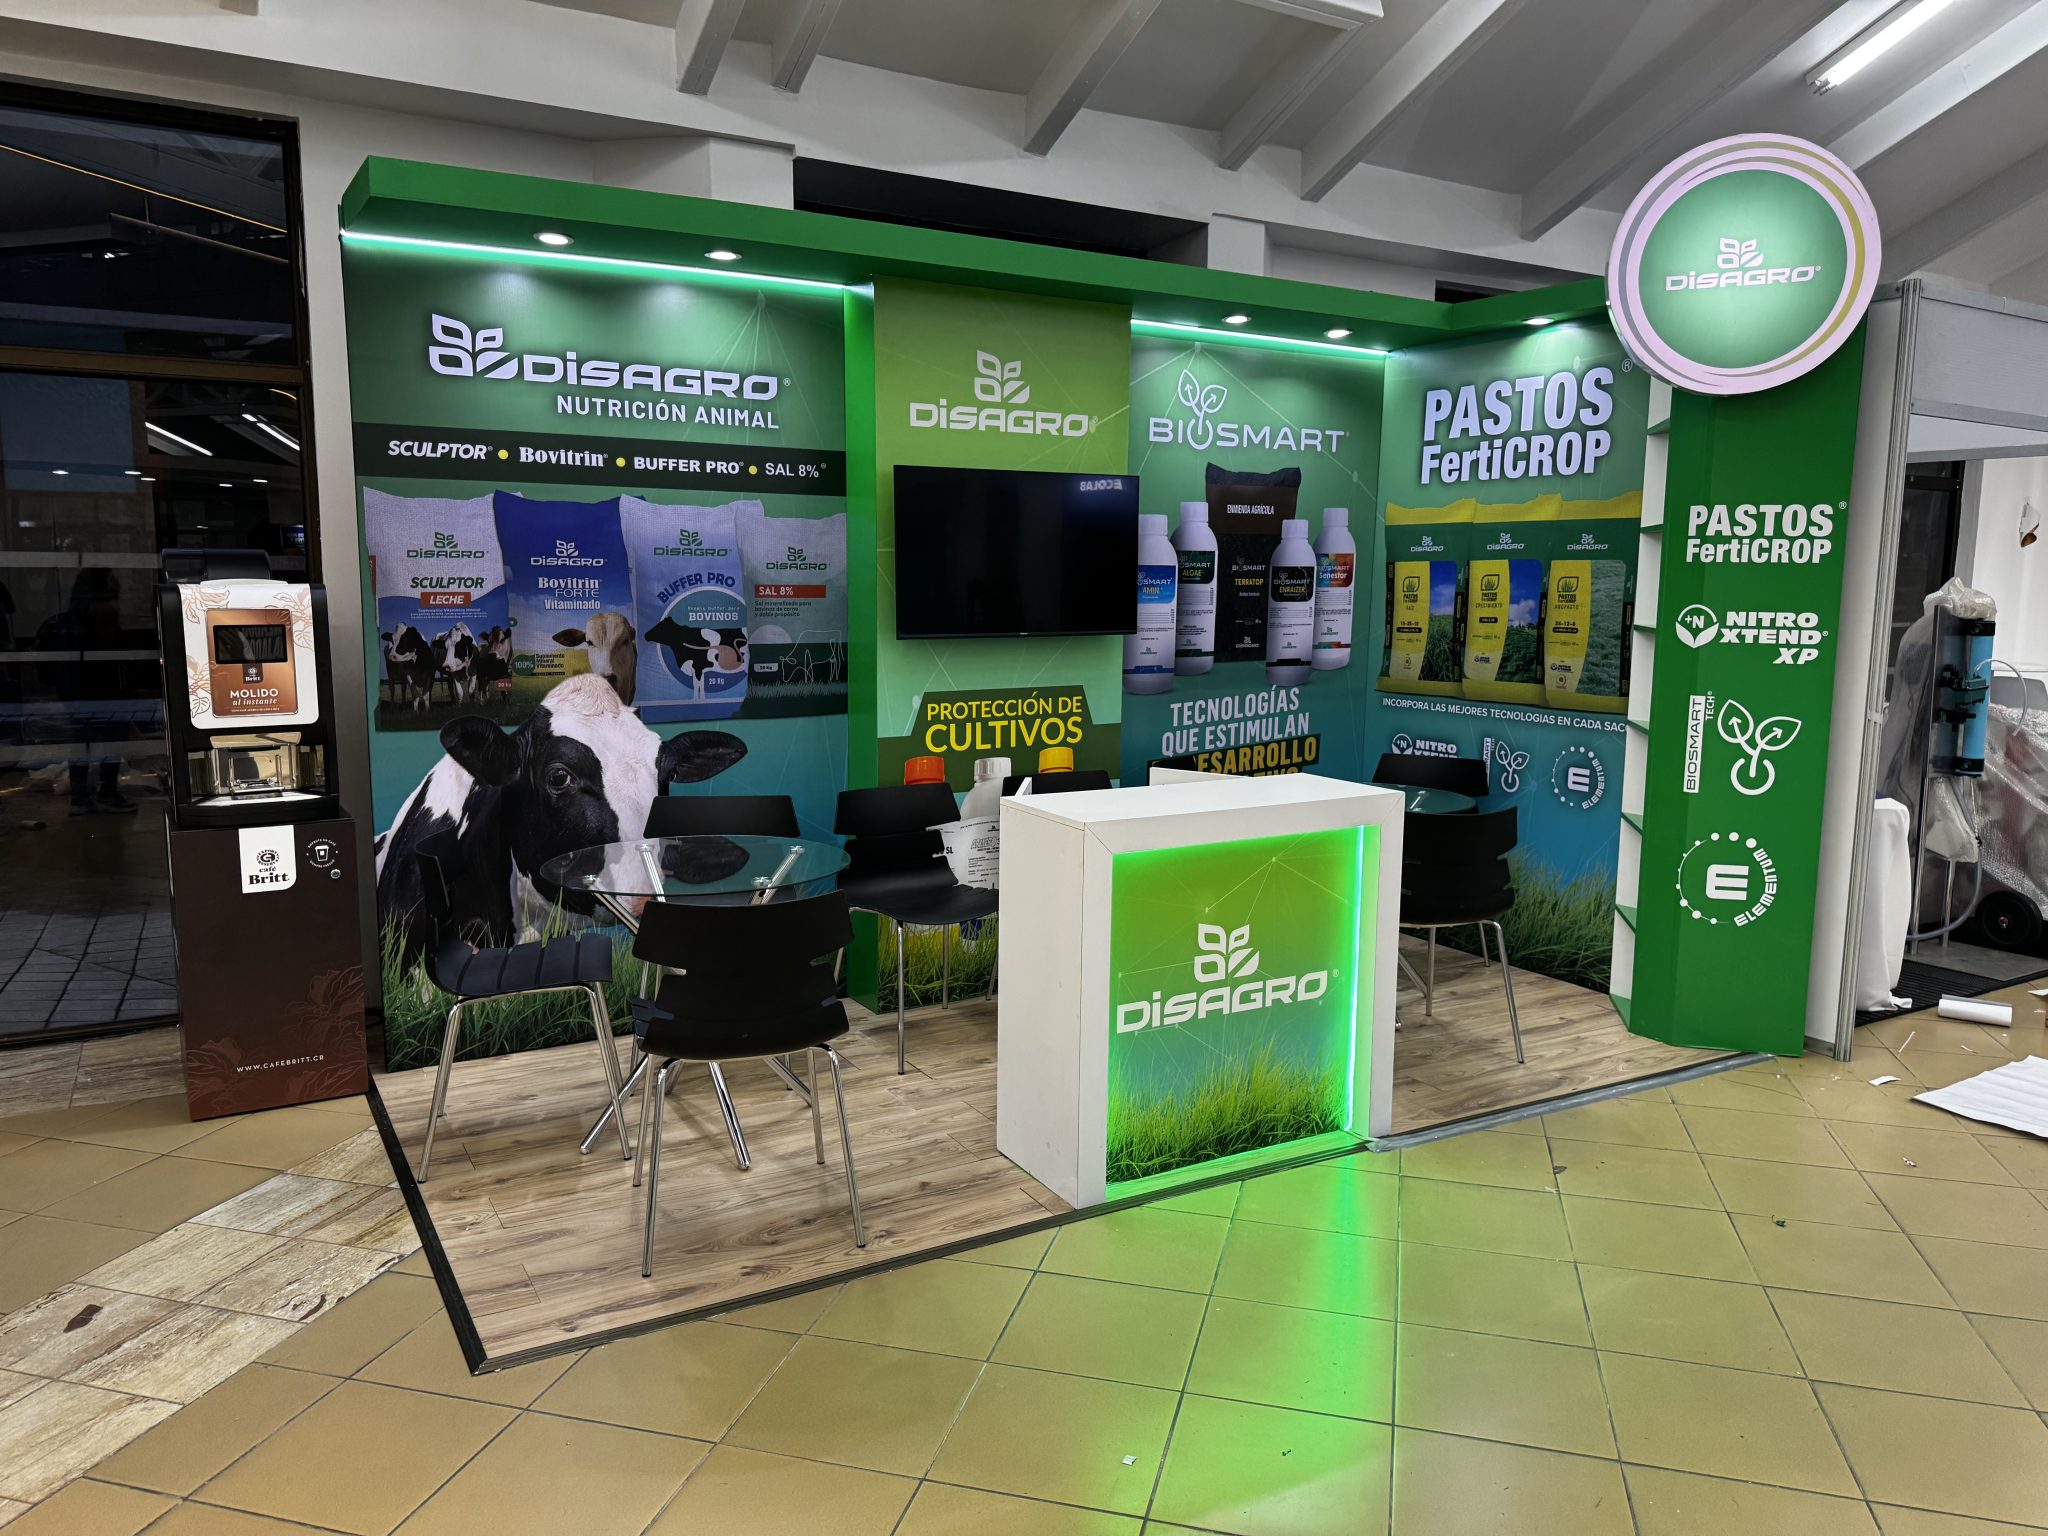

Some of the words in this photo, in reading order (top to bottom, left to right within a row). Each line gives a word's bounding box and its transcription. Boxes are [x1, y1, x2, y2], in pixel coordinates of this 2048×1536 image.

[556, 394, 686, 424] NUTRICIÓN
[694, 405, 779, 430] ANIMAL
[1423, 367, 1614, 442] PASTOS
[1149, 416, 1344, 453] BIOSMART
[388, 440, 488, 461] SCULPTOR
[518, 446, 605, 468] Bovitrin
[633, 456, 701, 473] BUFFER
[705, 460, 741, 475] PRO
[765, 462, 794, 477] SAL
[798, 464, 820, 479] 8%
[1421, 429, 1611, 485] FertiCROP
[1227, 504, 1250, 514] ENMIENDA
[1251, 504, 1274, 515] AGRÍCOLA
[1688, 504, 1834, 537] PASTOS
[1686, 538, 1832, 564] FertiCROP
[410, 576, 484, 590] SCULPTOR
[538, 577, 600, 590] Bovitrin
[656, 572, 704, 604] BUFFER
[707, 572, 736, 588] PRO
[759, 587, 778, 596] SAL
[780, 586, 794, 596] 8%
[1234, 578, 1264, 586] TERRATOP
[429, 595, 464, 605] LECHE
[555, 588, 600, 598] FORTE
[544, 599, 600, 610] Vitaminado
[688, 612, 738, 622] BOVINOS
[1726, 612, 1818, 628] NITRO
[1719, 628, 1822, 645] XTEND
[1772, 648, 1819, 664] XP
[230, 688, 278, 698] MOLIDO
[243, 698, 278, 706] instante
[927, 690, 1052, 721] PROTECCIÓN
[1058, 696, 1083, 714] DE
[1170, 684, 1300, 728] TECNOLOGÍAS
[1706, 696, 1716, 720] TECH
[1383, 698, 1429, 712] INCORPORA
[1430, 702, 1447, 712] LAS
[1448, 705, 1488, 718] MEJORES
[1490, 709, 1556, 724] TECNOLOGIAS
[1557, 716, 1572, 727] EN
[1573, 718, 1602, 730] CADA
[1604, 721, 1628, 733] SAC
[925, 716, 1084, 753] CULTIVOS
[1162, 728, 1199, 758] QUE
[1205, 712, 1310, 750] ESTIMULAN
[1416, 740, 1458, 754] NITRO
[1686, 698, 1704, 791] BIOSMART
[1193, 736, 1318, 774] ESARROLLO
[248, 872, 290, 885] Britt
[236, 1054, 324, 1073] WWW.CAFEBRITT.CR
